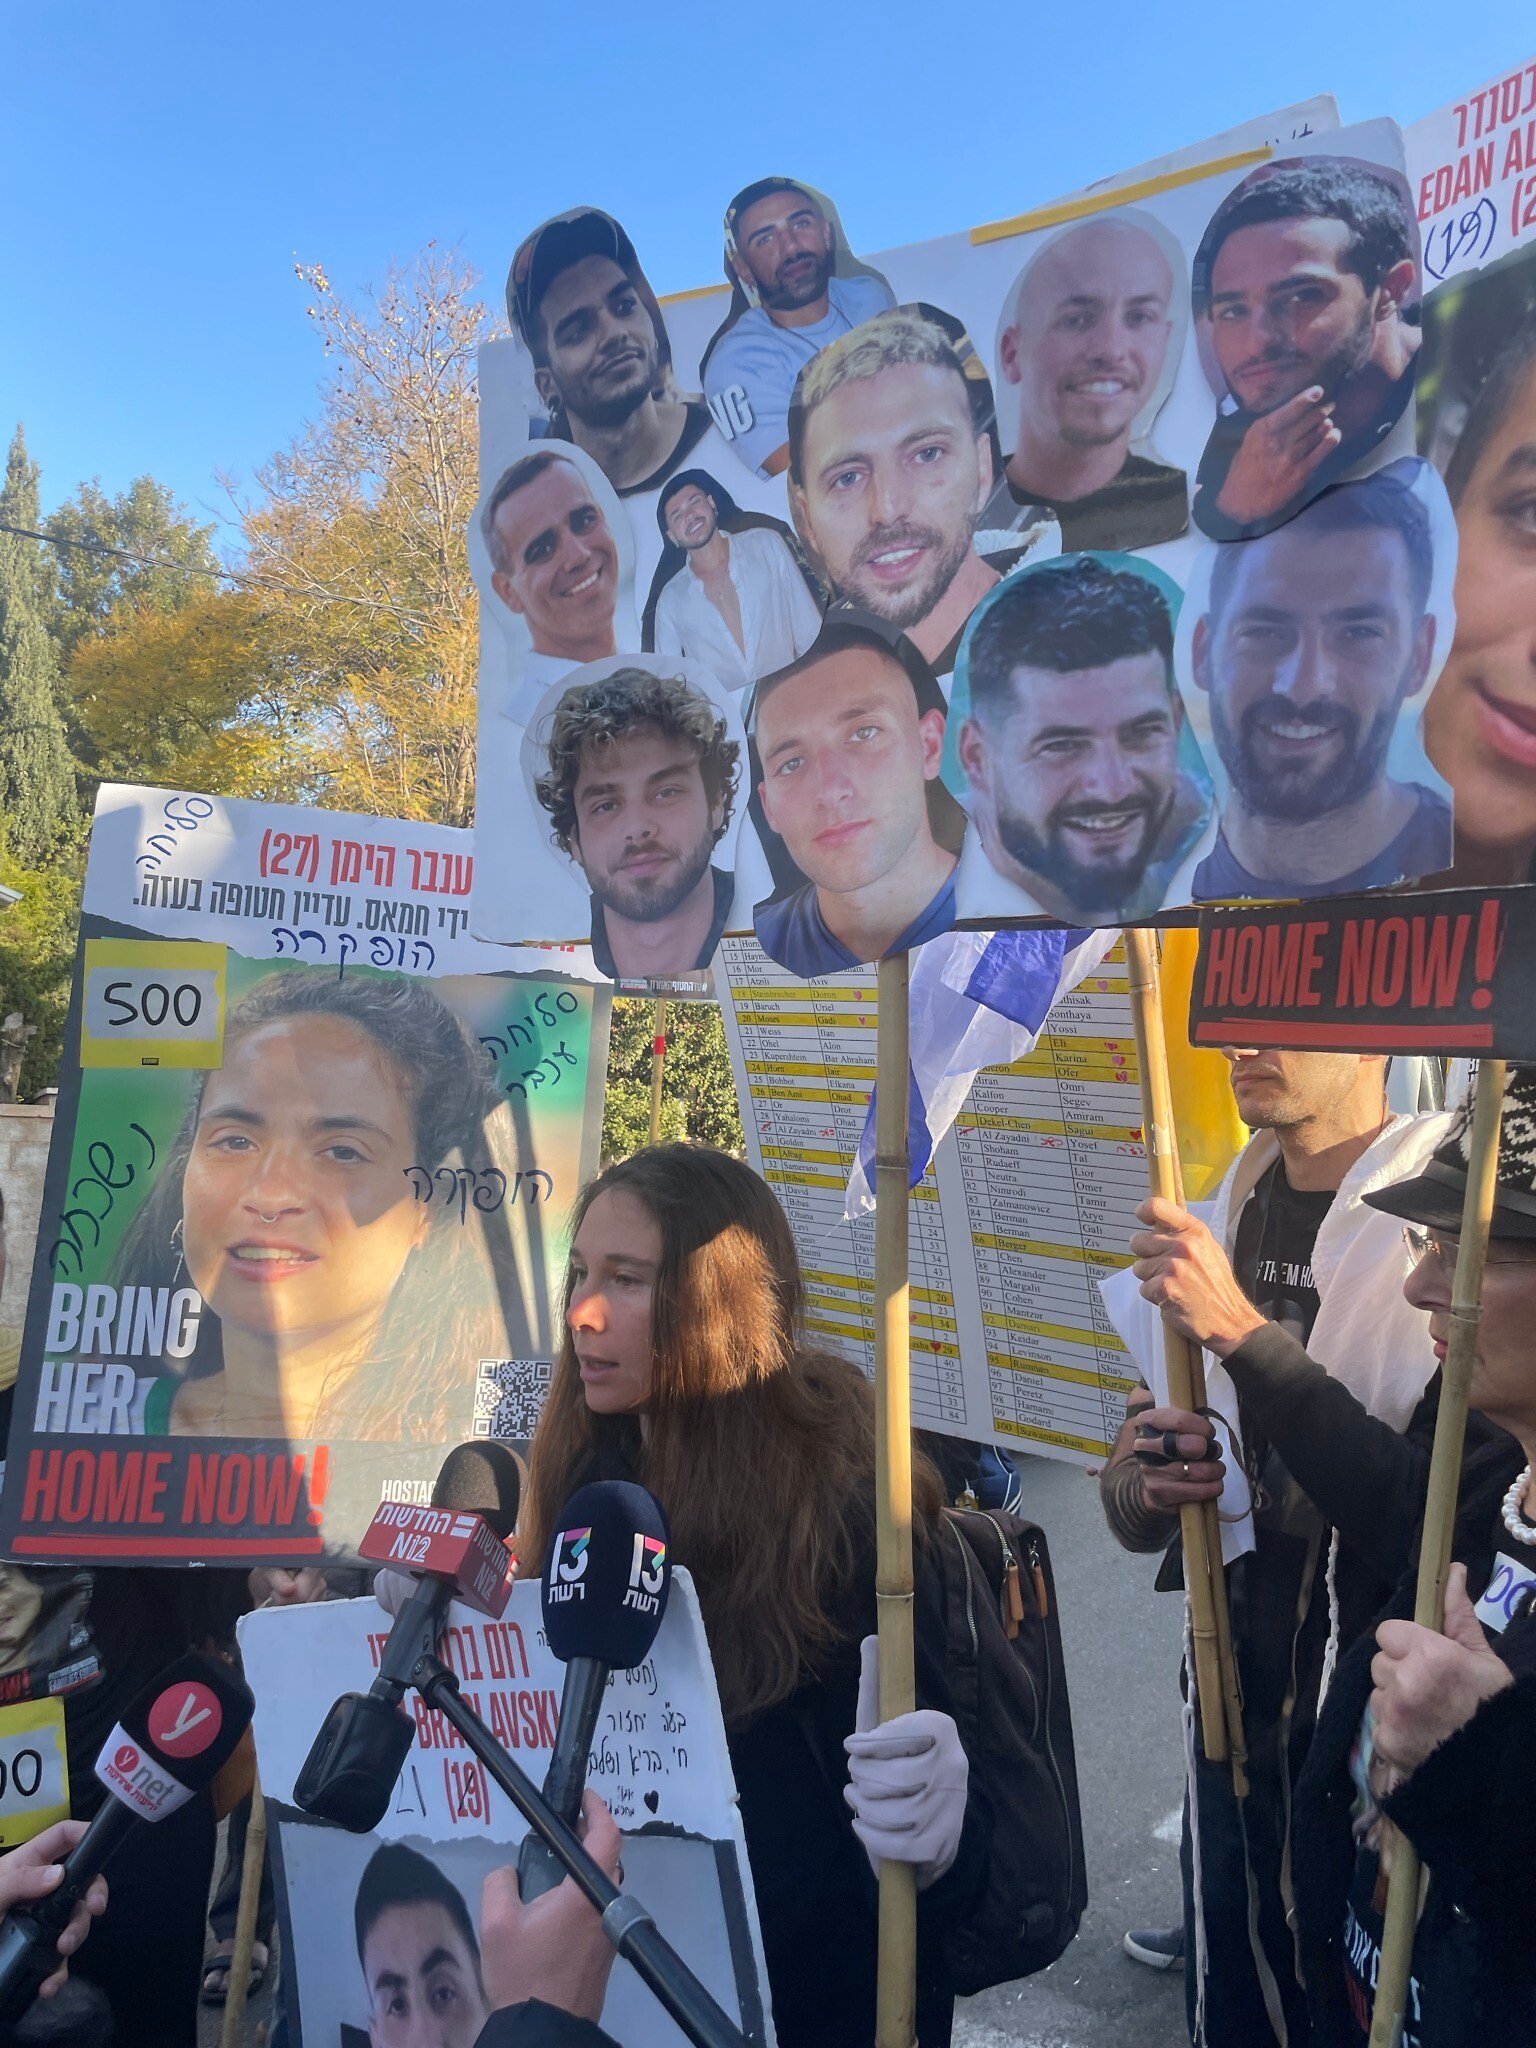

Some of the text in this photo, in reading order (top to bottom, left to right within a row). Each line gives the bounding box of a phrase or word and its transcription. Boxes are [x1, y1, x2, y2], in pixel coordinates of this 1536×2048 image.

[1418, 141, 1495, 222] EDAN
[136, 797, 213, 870] סליחה
[260, 829, 473, 895] ענבר הימן (27)
[132, 874, 203, 911] בעזה.
[210, 881, 285, 920] חטופה
[293, 891, 351, 926] עדיין
[357, 899, 429, 936] חמאס.
[272, 930, 435, 980] הופקרה
[1202, 899, 1500, 1010] HOME NOW!
[747, 965, 762, 973] Mor
[104, 982, 201, 1026] 500
[752, 990, 796, 998] Steinbrecher
[755, 1003, 835, 1012] Baruch Uriel
[479, 991, 578, 1061] סליחה
[818, 1017, 835, 1025] Gadi
[1051, 1024, 1077, 1033] Yossi
[762, 1040, 841, 1050] Ohel Alon
[765, 1052, 875, 1064] Kupershtein Bar Abraham
[1055, 1054, 1087, 1063] Karina
[506, 1041, 578, 1098] ענבר
[1058, 1068, 1078, 1077] Ofer
[769, 1077, 855, 1089] Bohbot Elkana
[1061, 1083, 1084, 1092] Omri
[771, 1089, 785, 1097] Ben
[832, 1093, 852, 1101] Ohad
[774, 1101, 782, 1109] Or
[975, 1089, 1091, 1107] Kalfon Segev
[836, 1118, 856, 1127] Ohad
[977, 1103, 1104, 1123] Cooper Amiram
[980, 1117, 1094, 1136] Dekel-Chen Sagui
[780, 1137, 804, 1146] Goldin
[982, 1131, 994, 1139] Al
[996, 1133, 1030, 1145] Zayadni
[1070, 1139, 1097, 1149] Yosef
[984, 1145, 1088, 1163] Shoham Tal
[784, 1162, 818, 1172] Samerano
[986, 1157, 1094, 1178] Rudaeff Lior
[786, 1174, 806, 1183] Bibas
[988, 1171, 1103, 1192] Neutra Omer
[403, 1166, 554, 1226] הופקרה
[788, 1186, 808, 1196] David
[990, 1184, 1107, 1207] Nimrodi Tamir
[789, 1199, 810, 1208] Bibas
[992, 1198, 1050, 1214] Zalmanowicz
[791, 1211, 874, 1228] Ohana Yosef
[994, 1212, 1103, 1234] Berman Gali
[793, 1223, 873, 1240] Levi Eitan
[997, 1225, 1100, 1248] Berman Ziv
[857, 1256, 870, 1265] Tal
[999, 1239, 1115, 1265] Berger Agam
[1000, 1252, 1107, 1278] Chen Itay
[1002, 1266, 1046, 1280] Alexander
[1003, 1279, 1041, 1293] Margalit
[1300, 1265, 1317, 1288] HO
[1005, 1292, 1033, 1305] Cohen
[45, 1282, 202, 1358] BRING
[1007, 1305, 1043, 1319] Mantzur
[1008, 1319, 1040, 1332] Damari
[1010, 1333, 1120, 1361] Keidar Ofra
[1012, 1346, 1123, 1378] Levinson Shay
[1014, 1373, 1117, 1402] Daniel Oz
[1016, 1387, 1043, 1399] Peretz
[33, 1361, 136, 1435] HER
[1018, 1400, 1054, 1415] Hamami
[1019, 1413, 1051, 1427] Godard
[1020, 1426, 1084, 1449] Suwannakham
[21, 1445, 330, 1526] HOME NOW!
[374, 1504, 452, 1534] החדשות
[389, 1532, 431, 1563] N12
[473, 1523, 510, 1576] החדשות
[548, 1582, 585, 1604] רשת
[622, 1594, 659, 1615] רשת
[483, 1621, 530, 1679] רום
[160, 1692, 212, 1741] y
